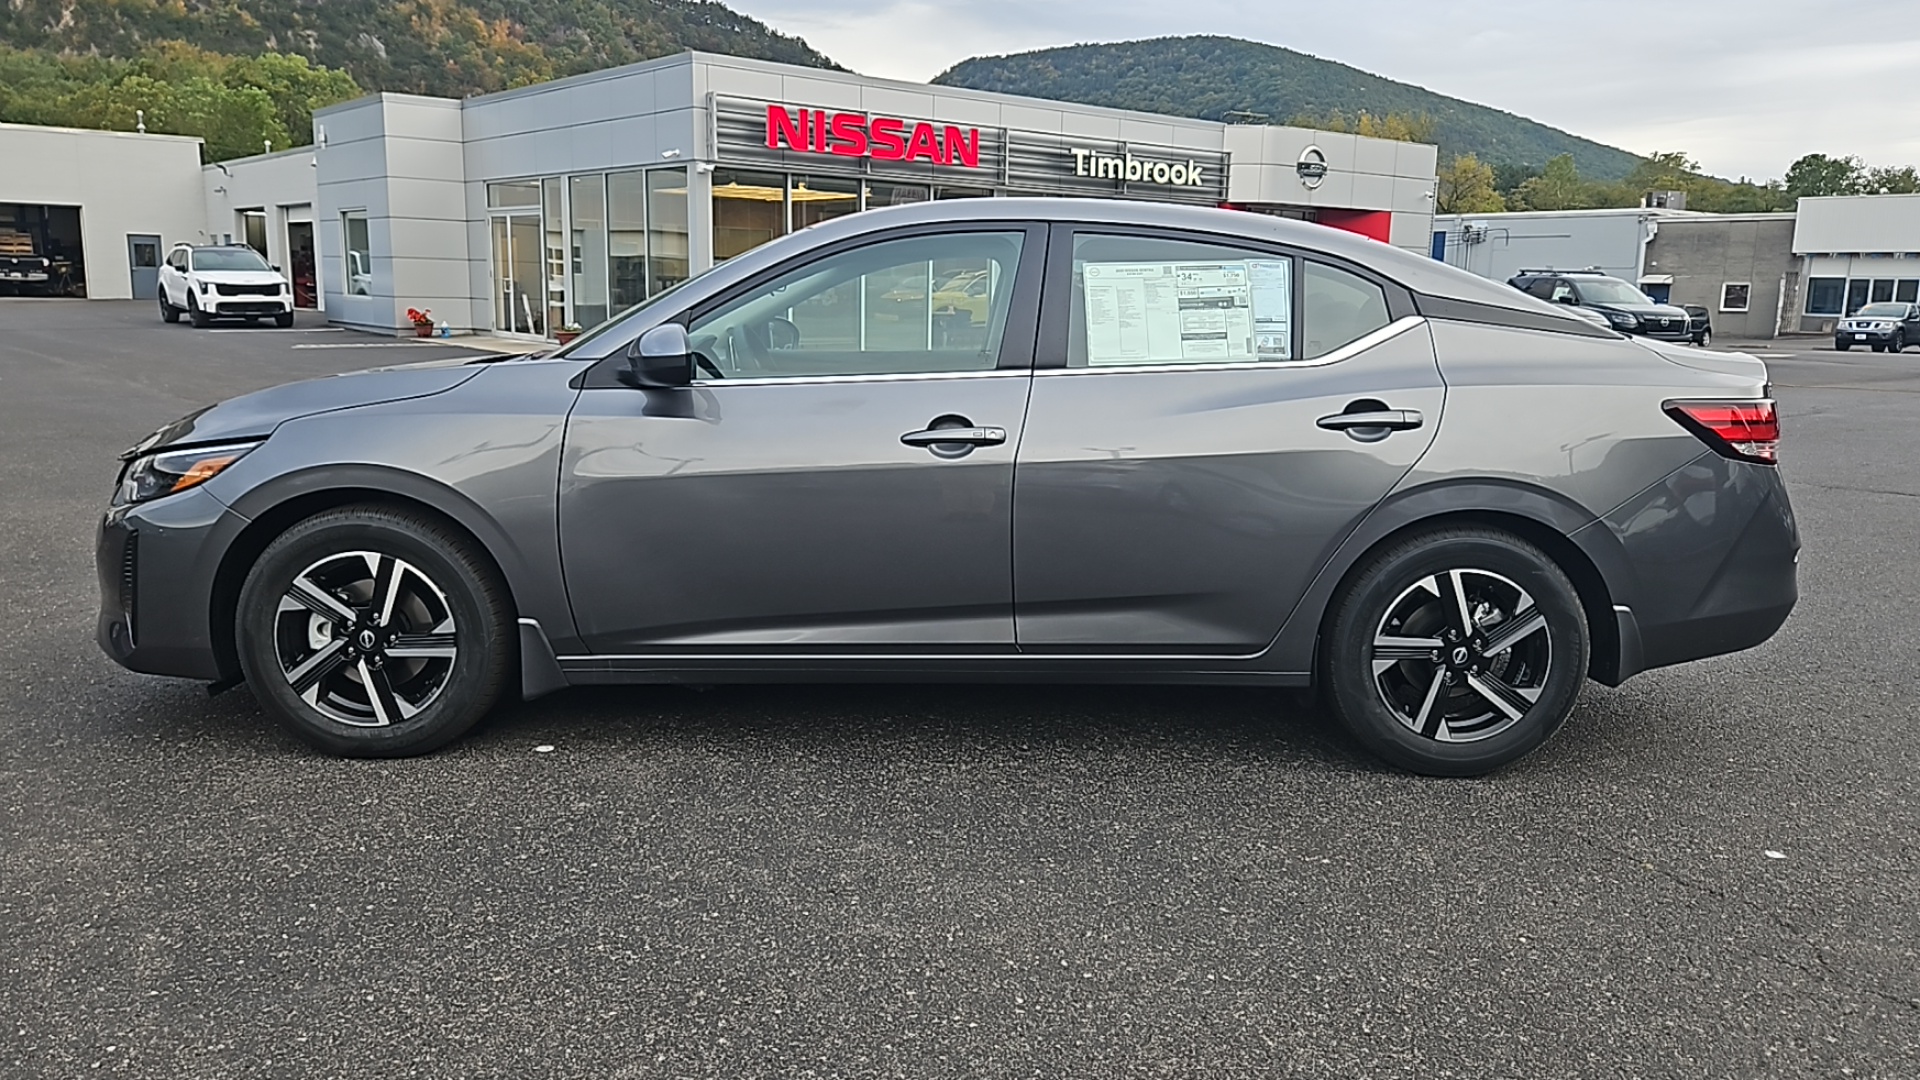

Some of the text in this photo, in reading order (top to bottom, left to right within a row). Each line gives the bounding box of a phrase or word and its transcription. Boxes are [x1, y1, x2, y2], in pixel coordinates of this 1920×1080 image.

[766, 104, 979, 167] NISSAN
[1071, 147, 1203, 186] Timbrook
[1181, 272, 1192, 281] 34
